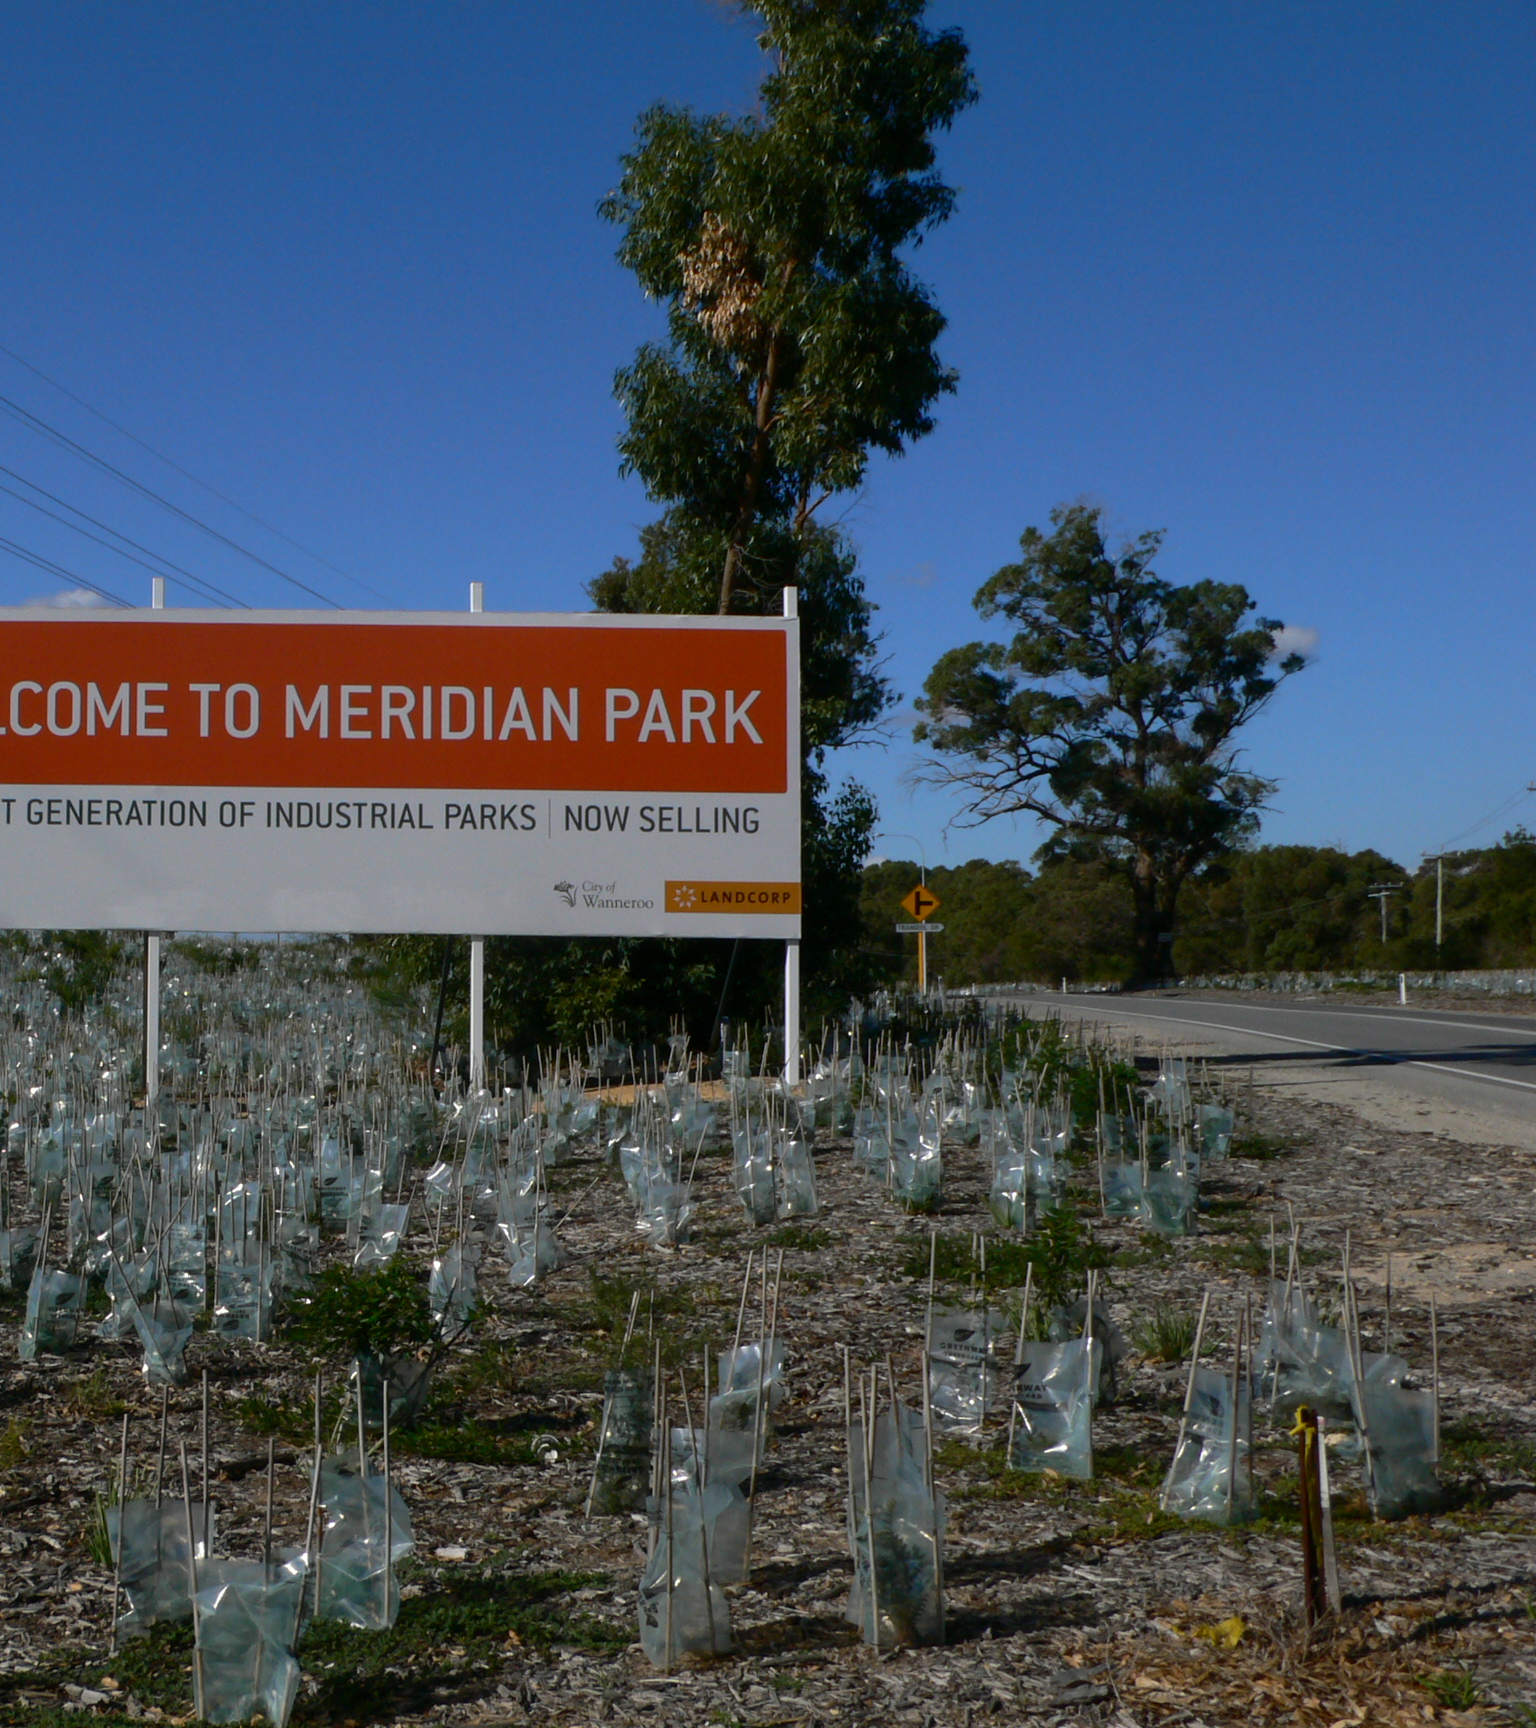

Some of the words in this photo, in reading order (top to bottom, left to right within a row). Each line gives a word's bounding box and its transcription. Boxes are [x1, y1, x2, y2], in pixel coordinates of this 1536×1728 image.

[190, 684, 259, 738] TO
[285, 685, 578, 741] MERIDIAN
[606, 689, 762, 743] PARK
[27, 799, 208, 827] GENERATION
[219, 801, 256, 827] OF
[267, 801, 433, 830] INDUSTRIAL
[445, 804, 536, 831] PARKS
[565, 805, 629, 832] NOW
[640, 807, 759, 834] SELLING
[581, 881, 603, 893] City
[605, 881, 617, 894] of
[701, 891, 791, 904] LANDCORP
[581, 894, 654, 909] Wanneroo
